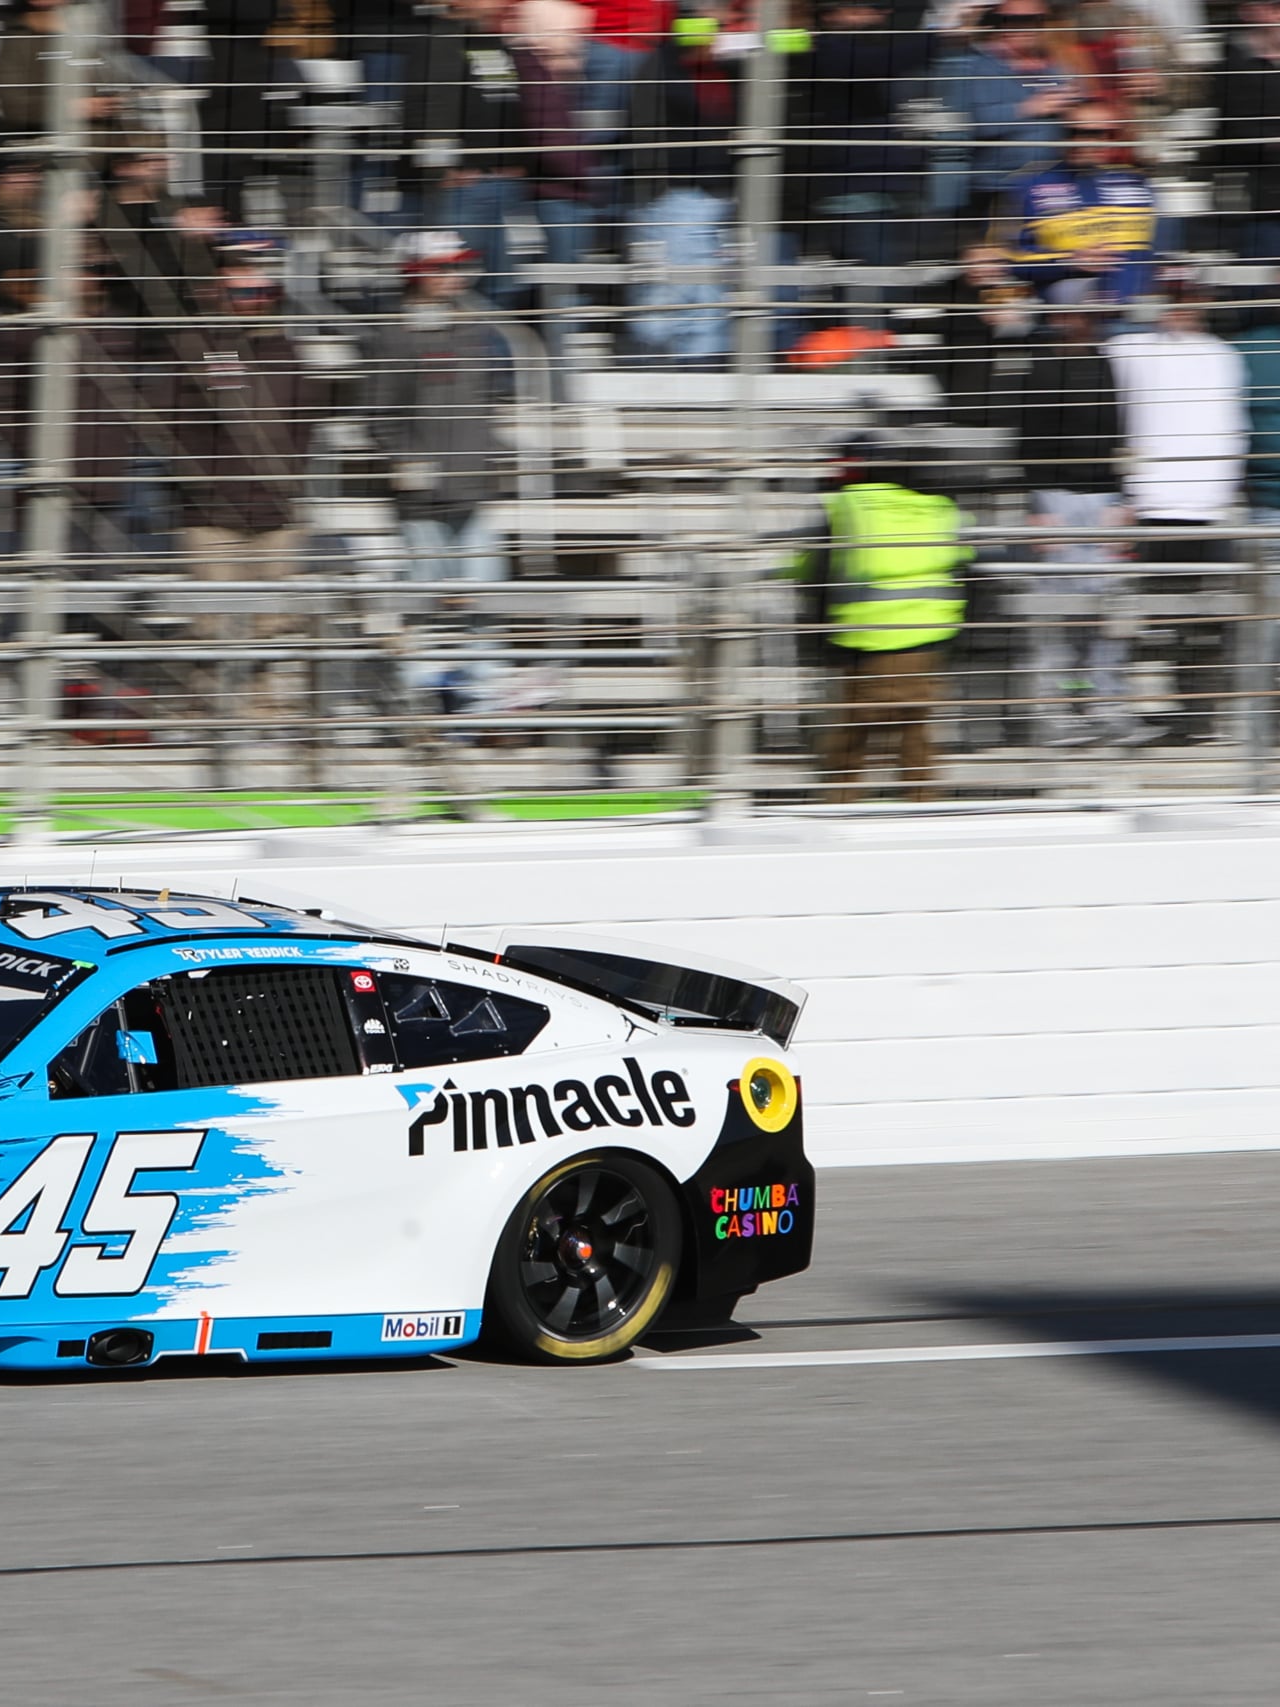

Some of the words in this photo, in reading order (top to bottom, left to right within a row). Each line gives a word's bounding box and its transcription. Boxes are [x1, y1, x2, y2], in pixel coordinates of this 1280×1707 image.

[197, 947, 243, 960] TYLER
[240, 946, 302, 959] REDDICK
[394, 1056, 697, 1157] Pinnacle
[710, 1183, 799, 1214] CHUMBA
[714, 1209, 793, 1240] CASINO
[384, 1317, 440, 1338] Mobil
[446, 1316, 457, 1335] 1
